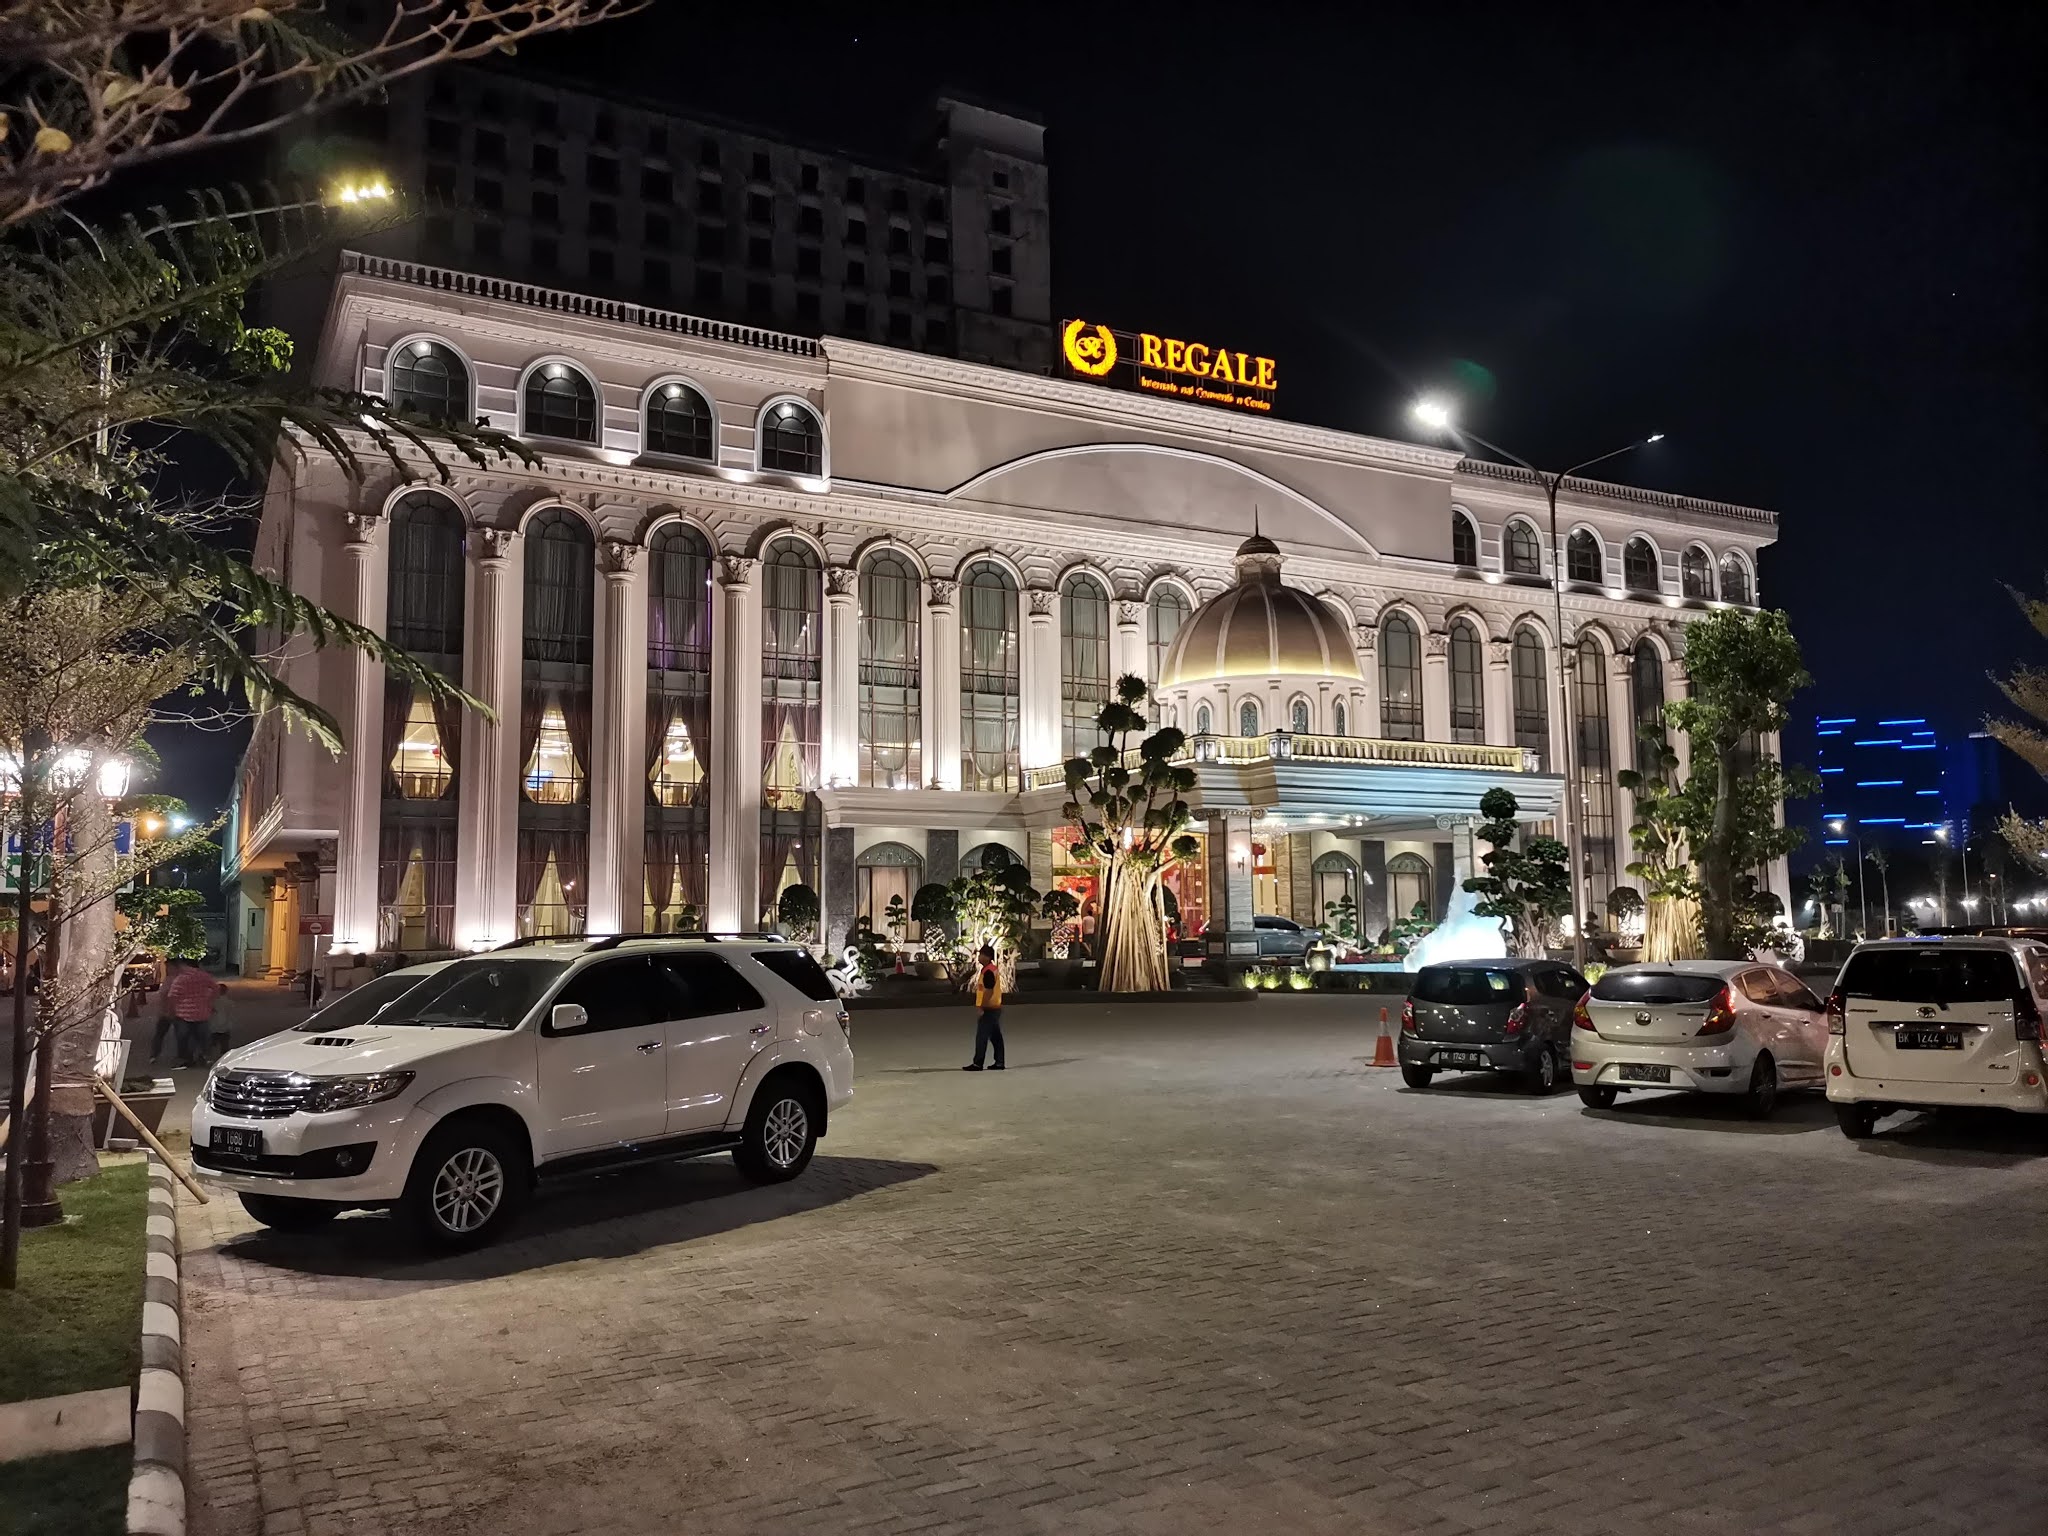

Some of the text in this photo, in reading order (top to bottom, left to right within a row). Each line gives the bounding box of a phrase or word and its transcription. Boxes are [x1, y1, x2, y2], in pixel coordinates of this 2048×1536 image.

[1140, 333, 1277, 389] REGALE
[1141, 376, 1194, 396] Internatinal
[1196, 387, 1243, 405] Conventin
[1898, 1032, 1909, 1043] BK
[1441, 1051, 1449, 1060] BK
[213, 1129, 222, 1143] BK
